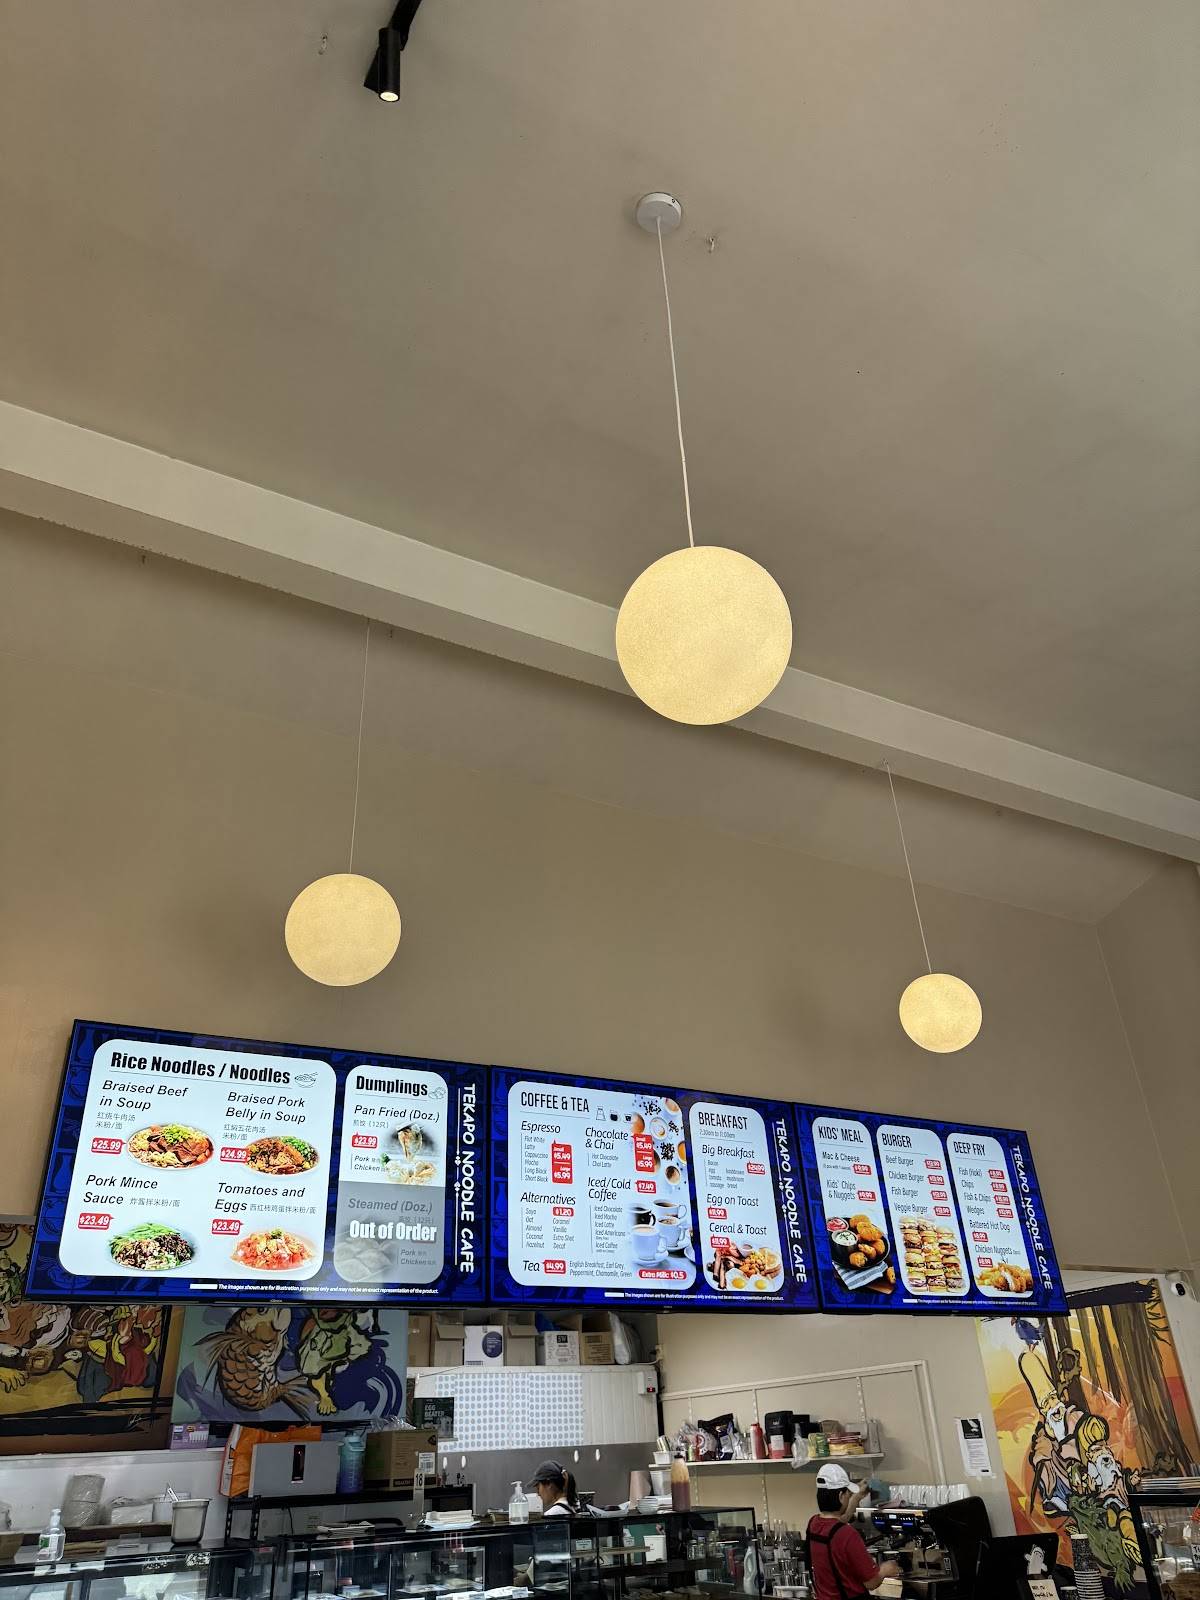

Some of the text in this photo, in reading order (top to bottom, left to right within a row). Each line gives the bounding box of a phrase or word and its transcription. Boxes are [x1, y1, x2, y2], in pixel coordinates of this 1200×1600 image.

[111, 1052, 290, 1084] Rice Noodles / Noodles
[102, 1080, 188, 1096] Braised Beef
[356, 1076, 428, 1096] Dumplings
[100, 1096, 151, 1111] in Soup
[228, 1092, 305, 1108] Braised Pork
[521, 1092, 589, 1112] COFFEE & TEA
[226, 1107, 306, 1124] Belly in Soup
[354, 1105, 440, 1122] Pan Fried (Doz.)
[521, 1120, 560, 1133] Espresso
[698, 1112, 747, 1130] BREAKFAST
[585, 1127, 628, 1140] Chocolate
[818, 1126, 863, 1143] KIDS' MEAL
[92, 1140, 121, 1150] $25.99
[585, 1139, 614, 1150] & Chai
[882, 1133, 912, 1148] BURGER
[221, 1150, 247, 1159] $24.99
[702, 1144, 754, 1159] Big Breakfast
[953, 1141, 985, 1156] DEEP FRY
[822, 1151, 833, 1160] Mac
[841, 1153, 860, 1162] Cheese
[886, 1155, 914, 1166] Beef Burger
[86, 1174, 158, 1189] Pork Mince
[460, 1083, 476, 1273] TEKAPO NOODLE CAFE
[588, 1177, 631, 1189] Iced/Cold
[889, 1171, 924, 1183] Chicken Burger
[218, 1182, 306, 1198] Tomatoes and
[842, 1181, 856, 1191] Chips
[962, 1180, 974, 1190] Chips
[84, 1192, 124, 1204] Sauce
[520, 1192, 576, 1205] Alternatives
[588, 1188, 617, 1201] Coffee
[828, 1190, 855, 1201] & Nuggets
[892, 1187, 918, 1198] Fish Burger
[979, 1194, 991, 1202] Chips
[215, 1198, 248, 1213] Eggs
[348, 1198, 432, 1215] Steamed (Doz.)
[707, 1194, 722, 1206] Egg
[738, 1196, 759, 1207] Toast
[776, 1118, 807, 1282] TEKAPO NOODLE CAFE
[894, 1203, 928, 1214] Veggie Burger
[967, 1206, 985, 1216] Wedges
[79, 1216, 109, 1225] $23.49
[1013, 1145, 1053, 1290] TEKAPO NOODLE CAFE
[212, 1221, 239, 1231] $23.49
[350, 1220, 437, 1241] Out of Order
[710, 1222, 767, 1235] Cereal & Toast
[523, 1260, 540, 1271] Tea
